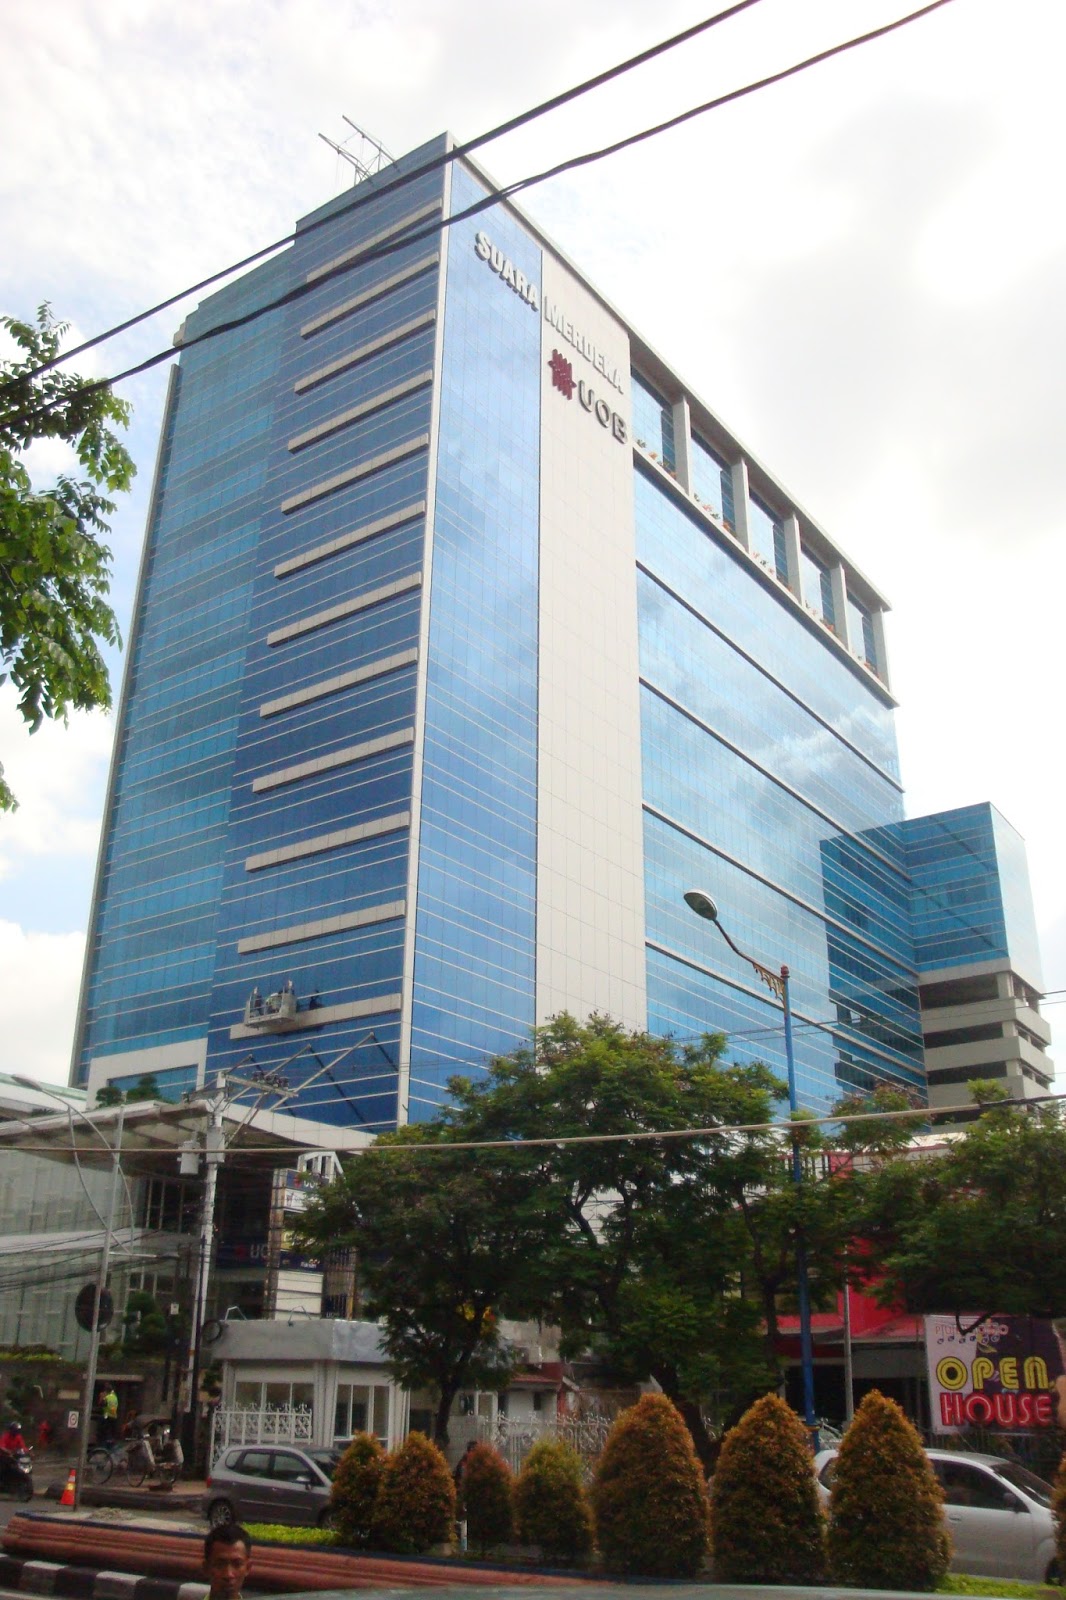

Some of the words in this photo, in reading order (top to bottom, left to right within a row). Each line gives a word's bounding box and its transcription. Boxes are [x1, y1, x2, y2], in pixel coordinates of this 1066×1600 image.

[475, 231, 539, 312] SUARA
[544, 295, 624, 395] MERDEKA
[578, 379, 629, 446] UOB
[936, 1356, 1049, 1391] OPEN
[940, 1392, 1052, 1427] HOUSE
